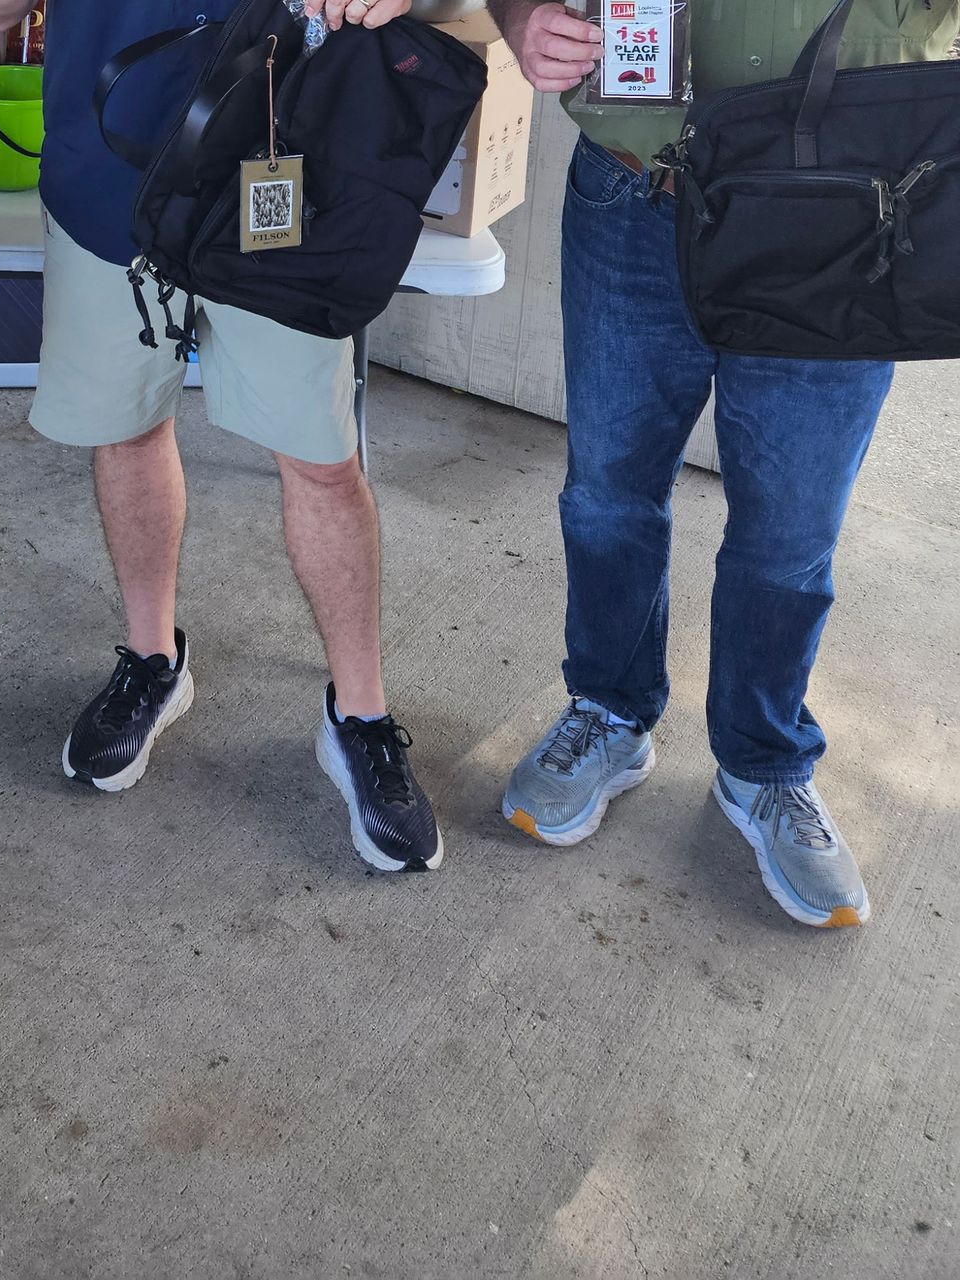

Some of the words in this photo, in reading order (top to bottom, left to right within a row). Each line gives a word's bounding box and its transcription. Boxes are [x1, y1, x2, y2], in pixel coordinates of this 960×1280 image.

[612, 4, 635, 17] CCIM
[617, 26, 658, 43] 1st
[615, 45, 660, 54] PLACE
[617, 53, 657, 62] TEAM
[253, 231, 290, 242] FILSON
